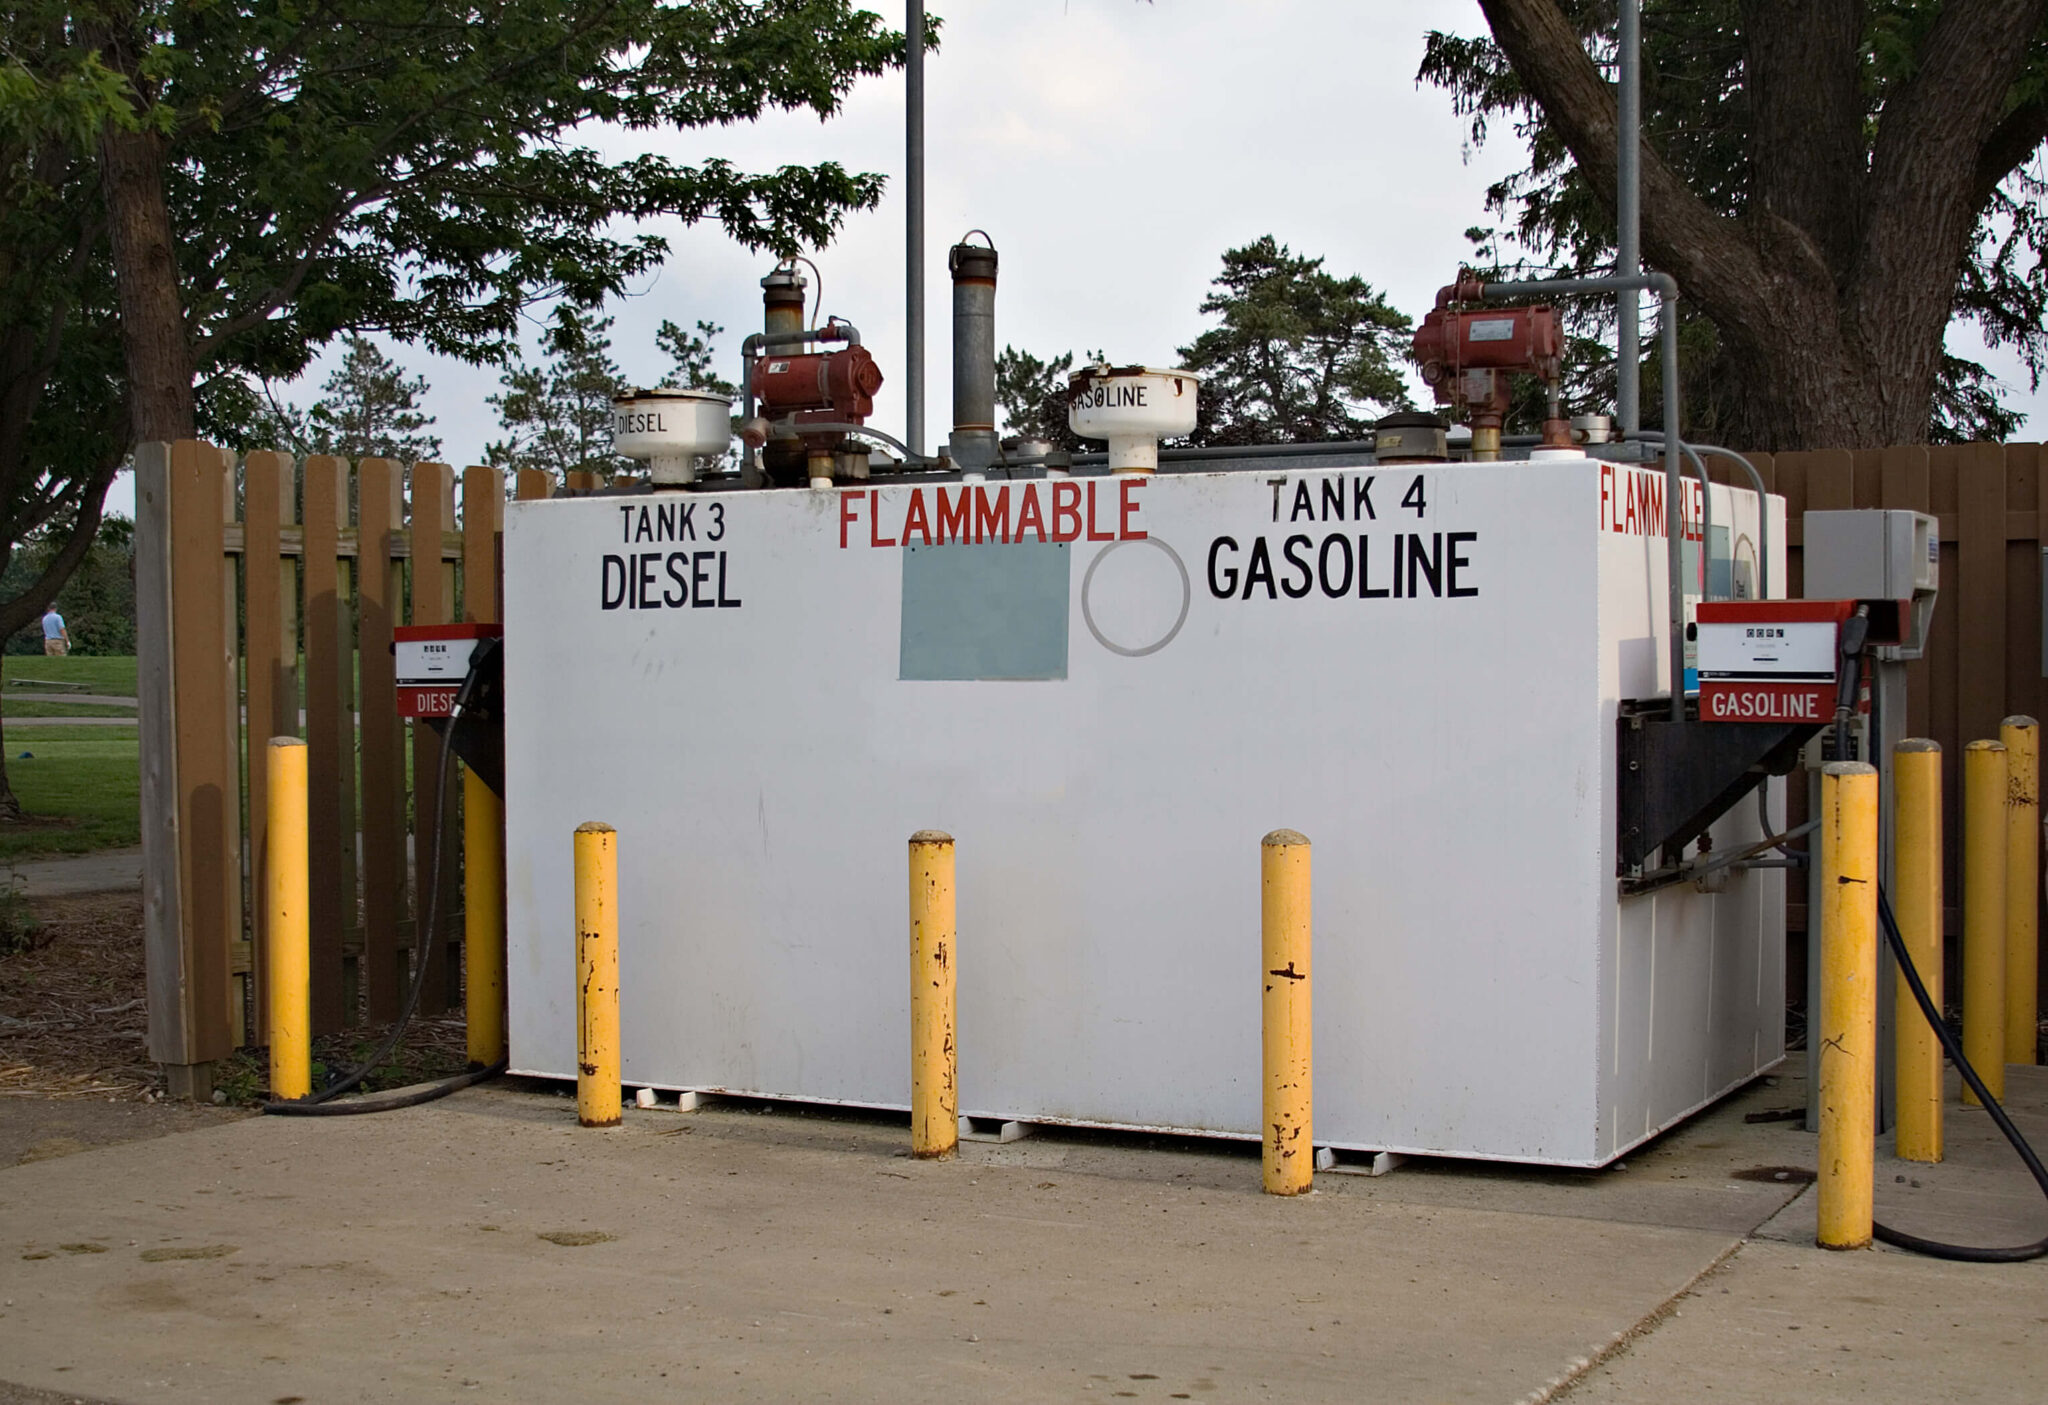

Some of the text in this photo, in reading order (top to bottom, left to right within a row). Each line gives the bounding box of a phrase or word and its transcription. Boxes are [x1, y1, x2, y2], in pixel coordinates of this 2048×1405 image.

[618, 412, 668, 435] DIESEL
[620, 502, 726, 544] TANK 3
[839, 478, 1149, 549] FLAMMABLE
[1266, 474, 1427, 523] TANK 4
[1601, 464, 1704, 542] FLAMMLE
[601, 550, 742, 611] DIESEL
[1207, 531, 1479, 600] GASOLINE
[417, 693, 457, 712] DIESE
[1711, 692, 1819, 718] GASOLINE
